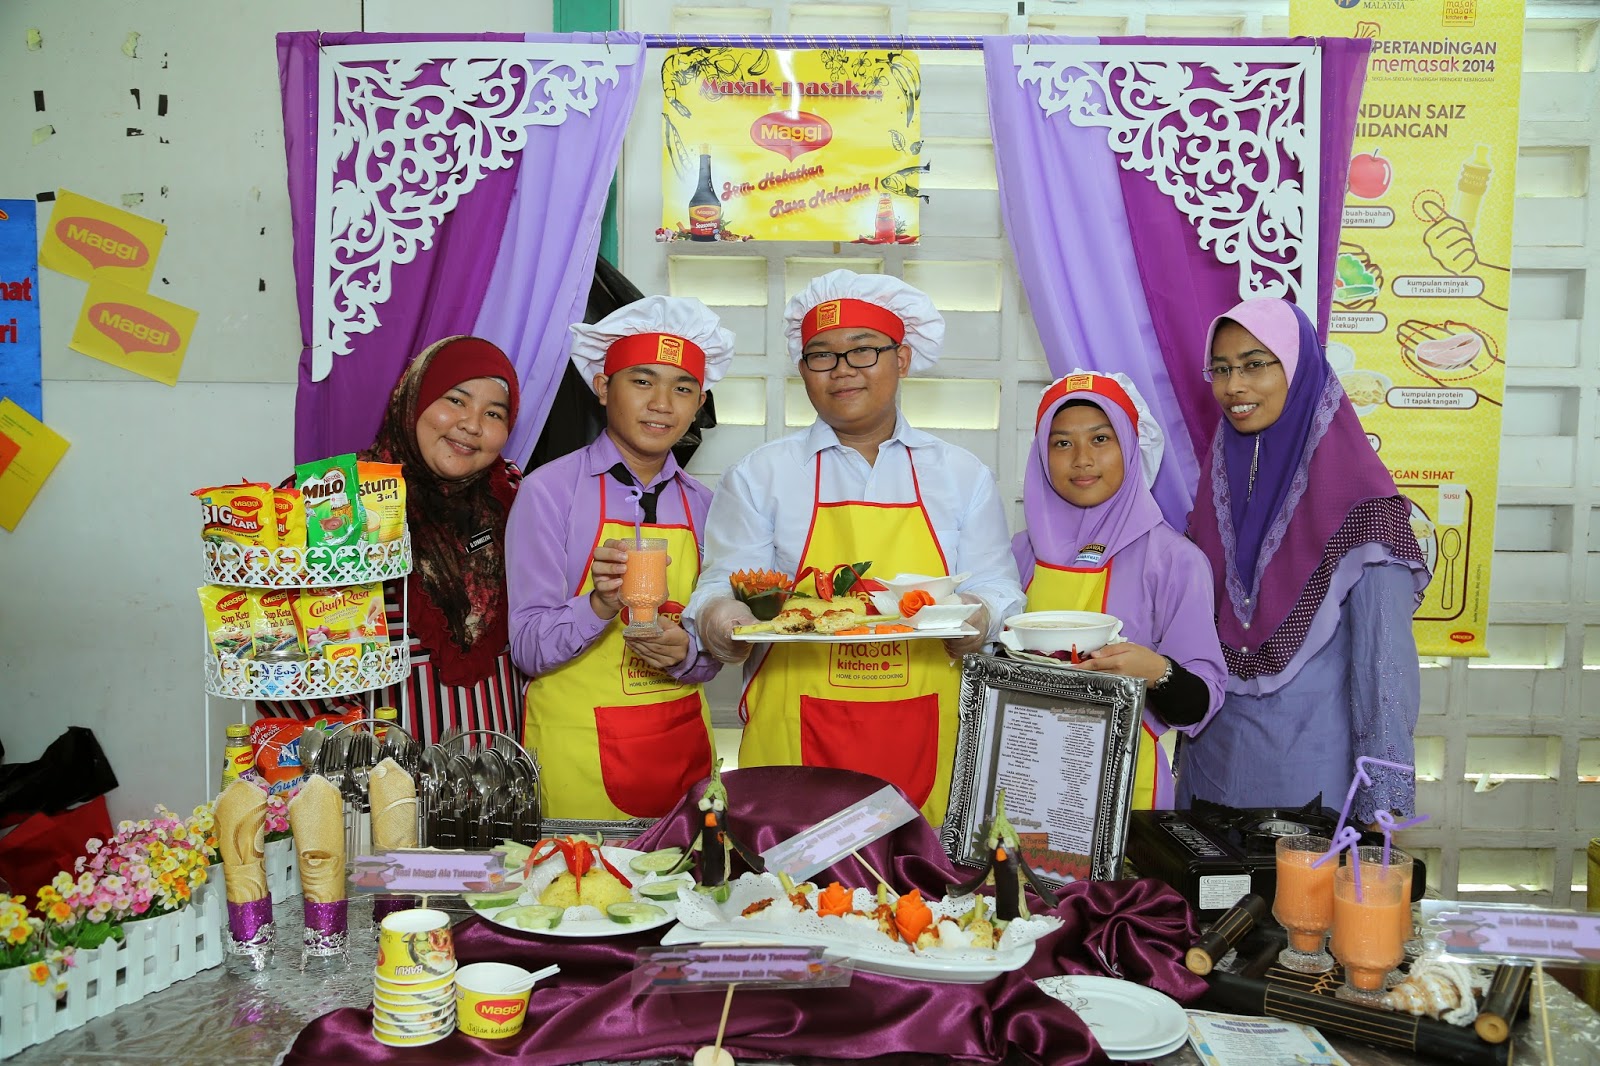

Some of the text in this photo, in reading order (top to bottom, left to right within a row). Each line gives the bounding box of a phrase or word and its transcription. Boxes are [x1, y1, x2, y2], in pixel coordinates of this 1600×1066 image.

[1372, 56, 1495, 73] memasak 2014
[1359, 103, 1466, 119] NDUAN SAIZ
[760, 124, 822, 143] Maggi
[758, 163, 825, 191] Hebatkan
[769, 199, 807, 218] Rasa
[808, 181, 871, 209] Malaysia
[1345, 209, 1391, 217] buah-buahan
[66, 224, 140, 261] Maggi
[99, 309, 171, 347] Maggi
[1336, 322, 1358, 330] cekup)
[1432, 398, 1460, 406] tangan)
[1388, 470, 1455, 480] GGAN SIHAT
[302, 479, 344, 499] MILO
[359, 478, 398, 497] stum
[376, 493, 384, 502] 3
[393, 490, 398, 500] 1
[234, 500, 260, 508] Maggi
[276, 502, 289, 510] ggi
[202, 504, 233, 525] BIG
[231, 518, 258, 530] KARI
[220, 593, 247, 610] Maggi
[263, 592, 287, 605] Magg
[308, 596, 341, 618] Cukup
[341, 589, 371, 607] Rasa
[221, 615, 235, 625] Sup
[264, 608, 291, 621] Sup Keta
[838, 641, 902, 659] masak
[837, 658, 879, 671] kitchen
[412, 868, 437, 878] Maggi
[437, 868, 452, 878] Ala
[481, 1002, 521, 1016] Maggi
[467, 1022, 489, 1035] Sajian
